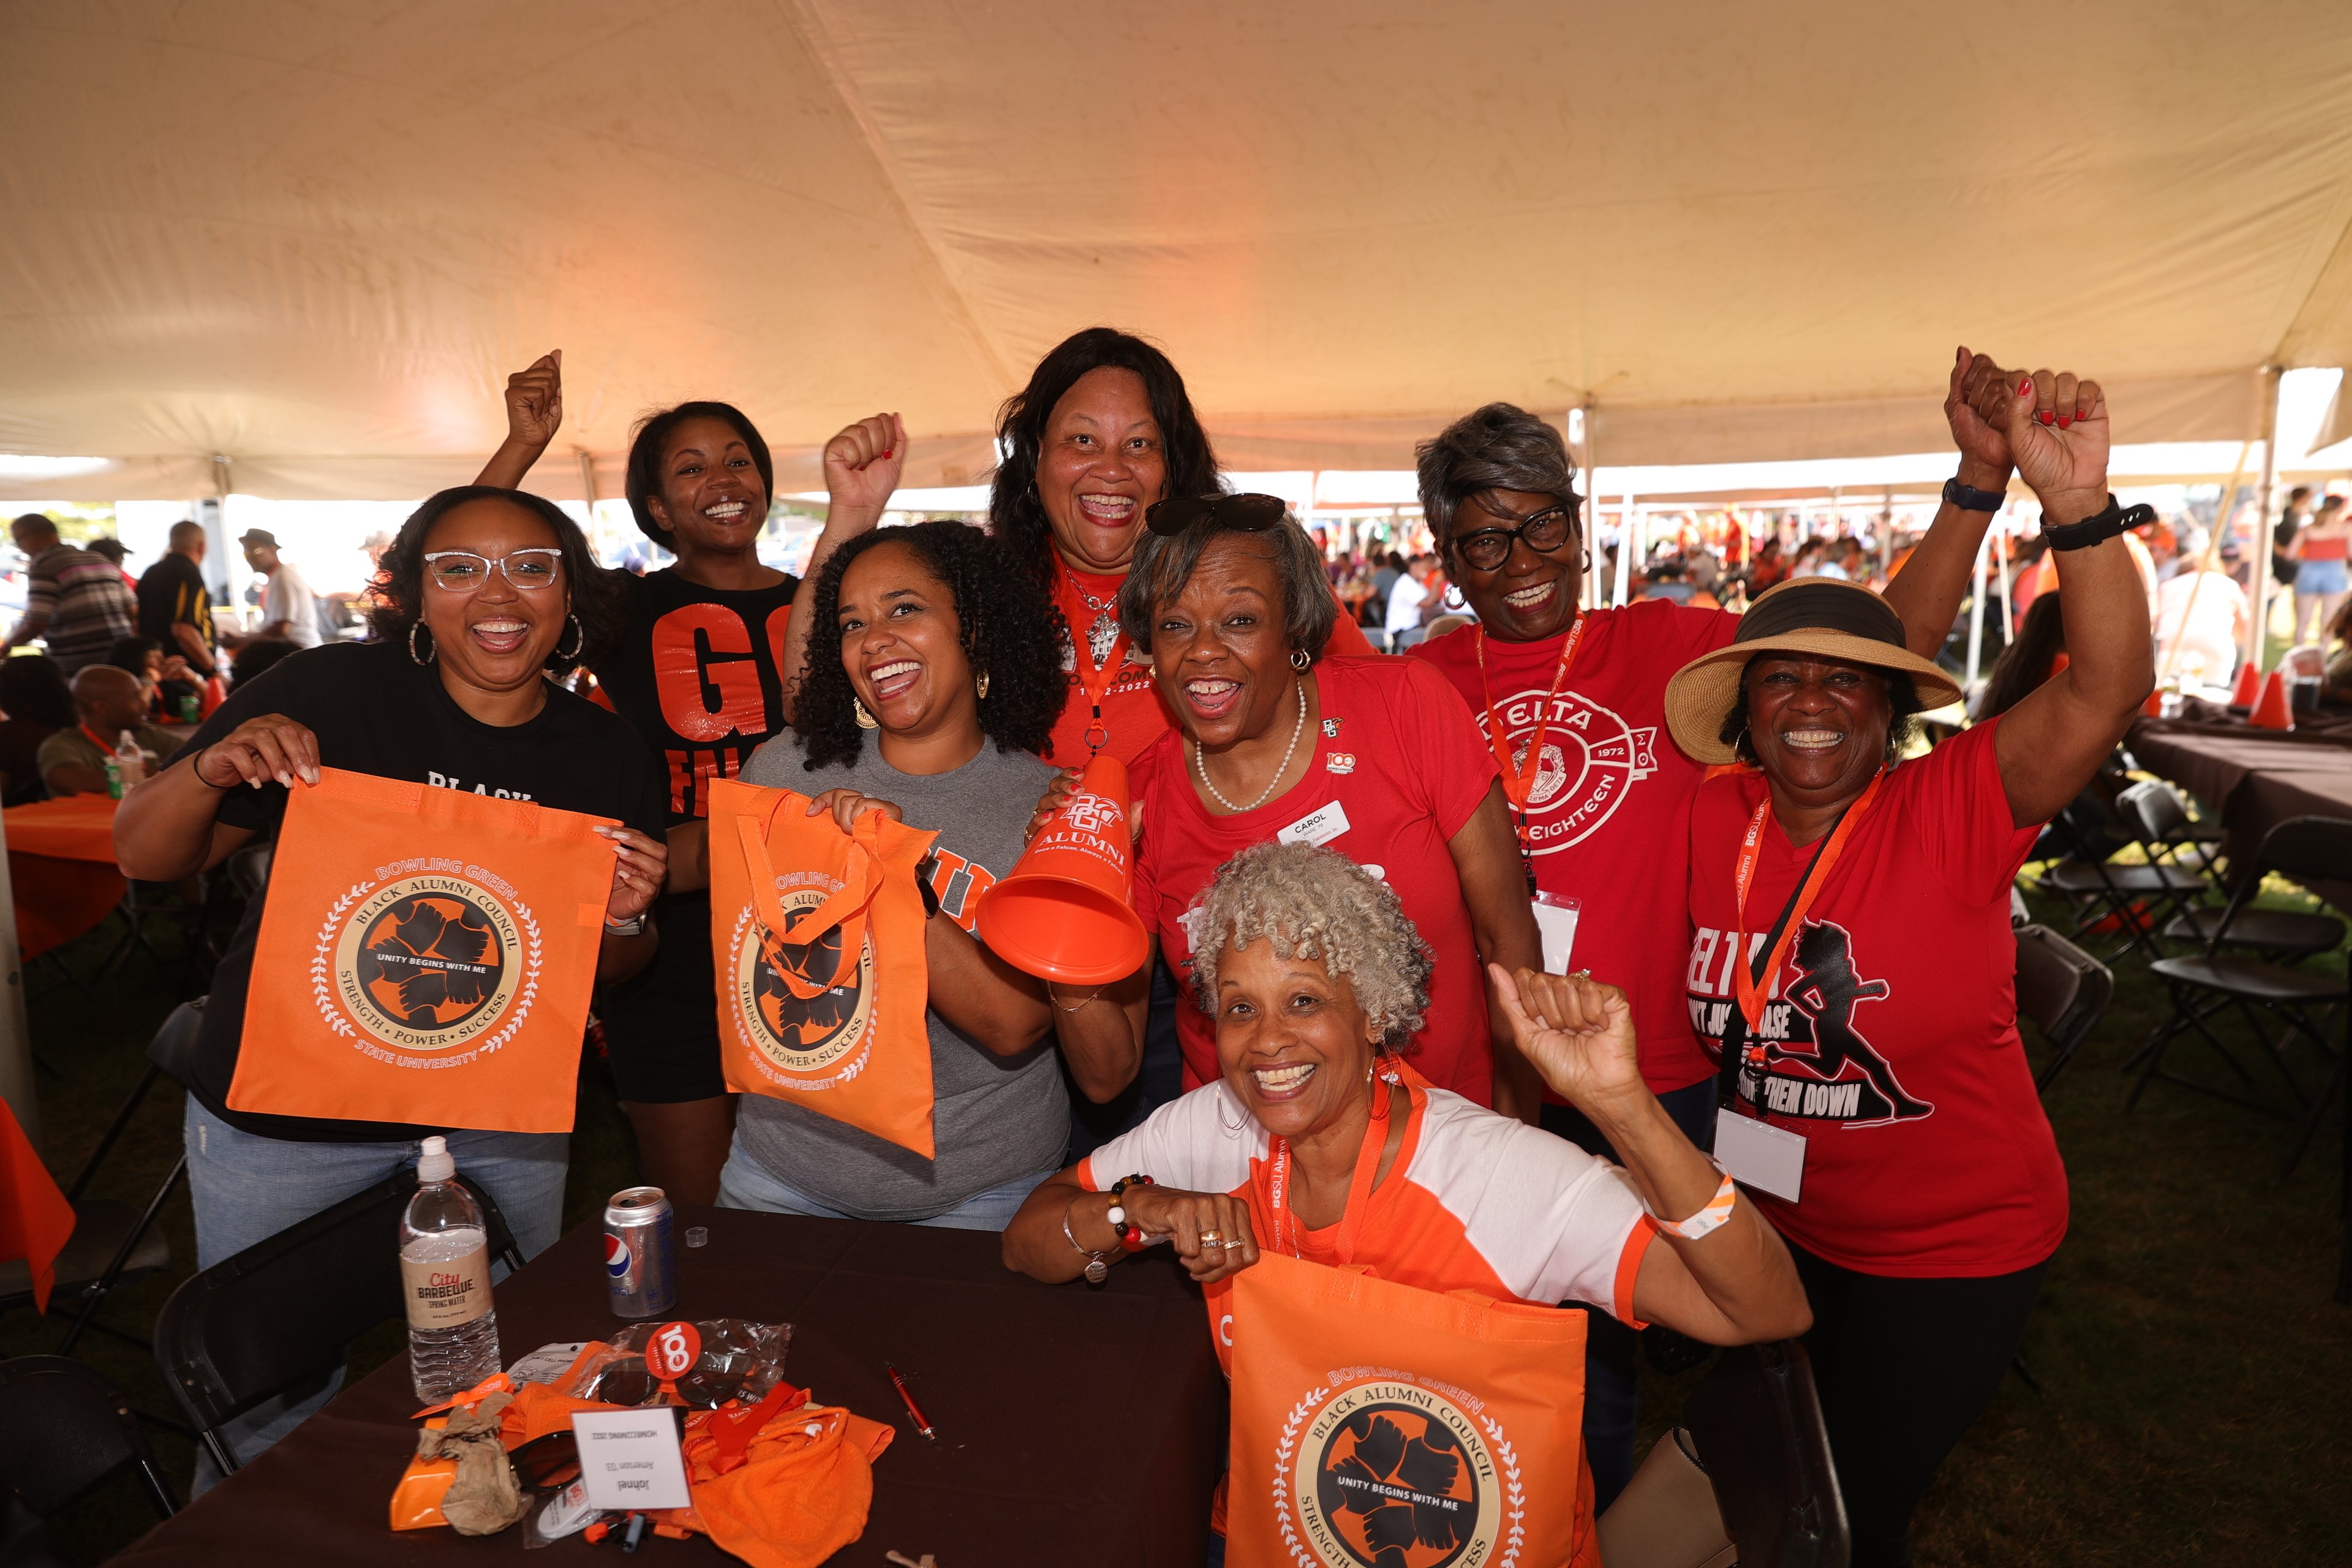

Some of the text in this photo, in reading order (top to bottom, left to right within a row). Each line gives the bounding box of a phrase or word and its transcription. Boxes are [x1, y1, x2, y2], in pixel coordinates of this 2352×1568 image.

[1080, 680, 1150, 695] 12-2022
[1328, 753, 1355, 767] 100
[1597, 747, 1625, 758] 1972
[1529, 774, 1616, 840] EIGHTEEN
[1295, 813, 1327, 833] CAROL
[1302, 827, 1317, 837] WARE
[1745, 820, 1761, 846] BGSU
[1038, 831, 1125, 867] ALUMNI
[1079, 847, 1103, 860] Always
[1107, 859, 1124, 876] Falcon
[375, 858, 519, 901] BOWLING GREEN
[775, 871, 830, 889] OWLING
[1736, 854, 1752, 884] Alumni
[794, 894, 826, 906] ALUM
[356, 880, 518, 951] BLACK ALUMNI COUNCIL
[377, 953, 487, 974] UNITY BEGINS WITH ME
[341, 970, 507, 1045] STRENGTH POWER SUCCESS
[742, 981, 863, 1066] STRENGTH POWER SUCCESS
[353, 1039, 478, 1069] STATE UNIVERSITY
[748, 1051, 837, 1091] STATE UNIVERSITY
[1765, 1076, 1804, 1114] THEM
[1803, 1083, 1861, 1117] DOWN
[1273, 1139, 1286, 1208] BGSU Alumni
[430, 1273, 460, 1289] City
[429, 1295, 466, 1308] SPRING WATER
[655, 1335, 668, 1376] HOMECOMING
[660, 1324, 690, 1372] 100
[1327, 1366, 1485, 1415] BOWLING GREEN
[609, 1430, 658, 1439] HOMECOMING
[1313, 1387, 1493, 1482] BLACK ALUMNI COUNCIL
[1337, 1476, 1458, 1511] UNITY BEGINS WITH ME
